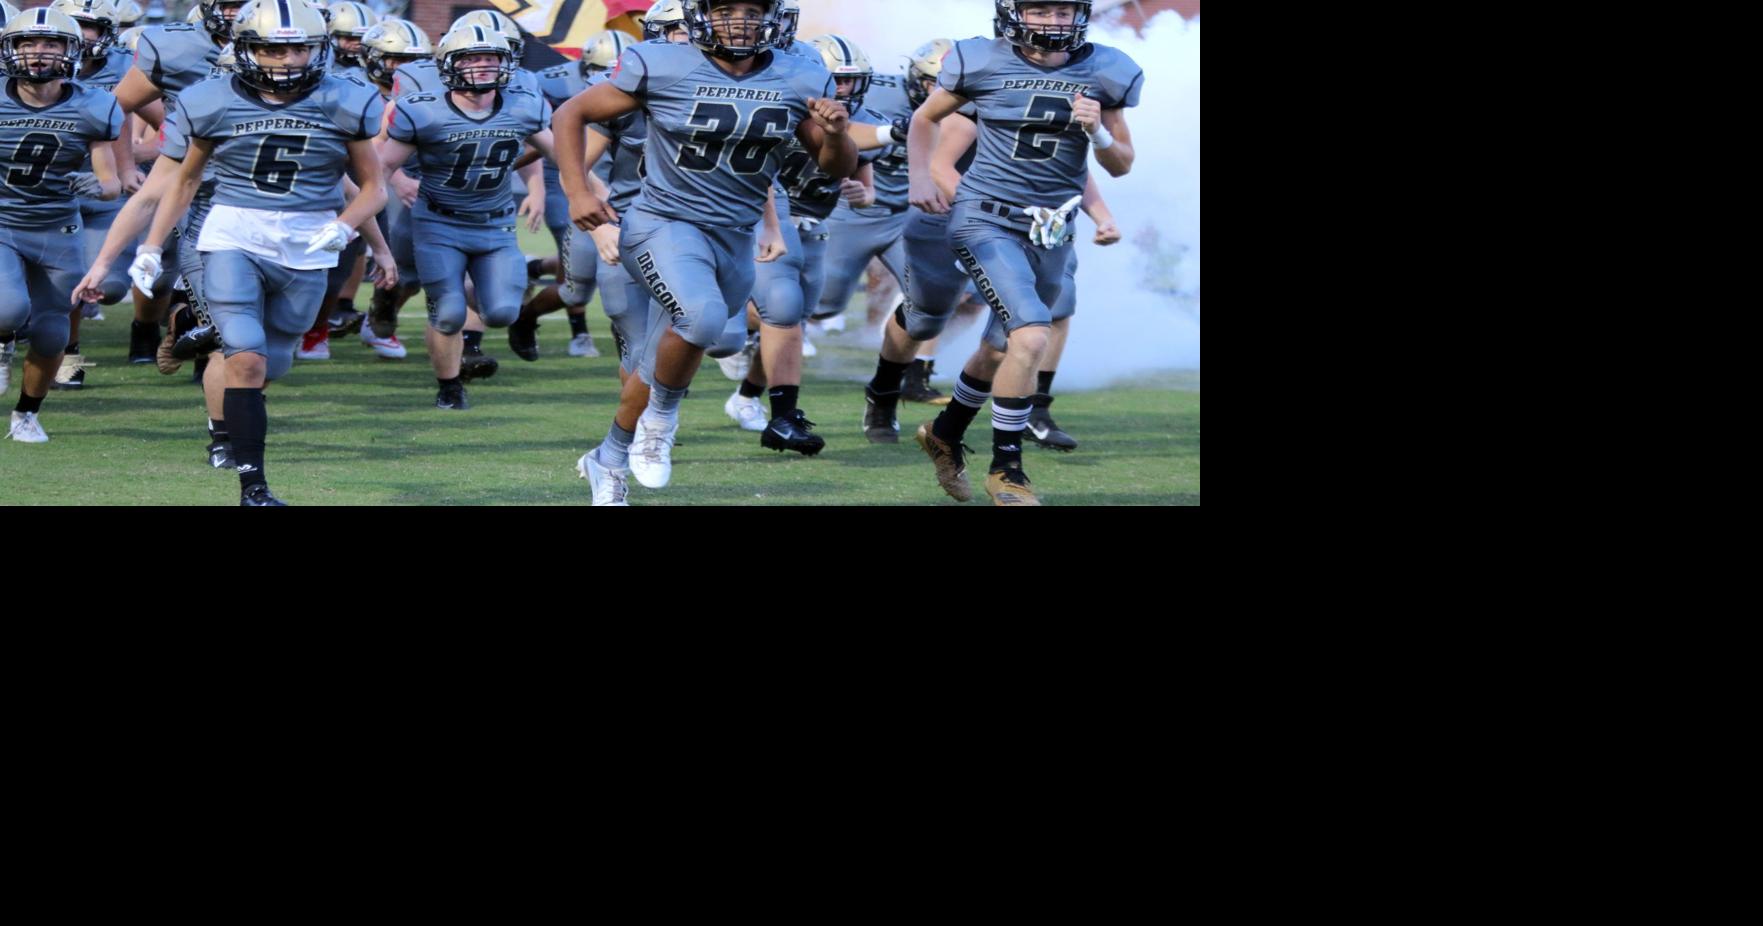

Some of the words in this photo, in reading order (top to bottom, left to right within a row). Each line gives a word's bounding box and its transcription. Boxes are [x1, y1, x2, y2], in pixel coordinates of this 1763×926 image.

[693, 85, 783, 103] PEPPERELL
[1001, 79, 1090, 97] PEPPERELL
[674, 100, 791, 176] 36
[1010, 93, 1075, 162] 2
[4, 131, 64, 189] 9
[250, 133, 311, 197] 6
[440, 138, 521, 192] 19
[955, 244, 1014, 324] DRAGONS
